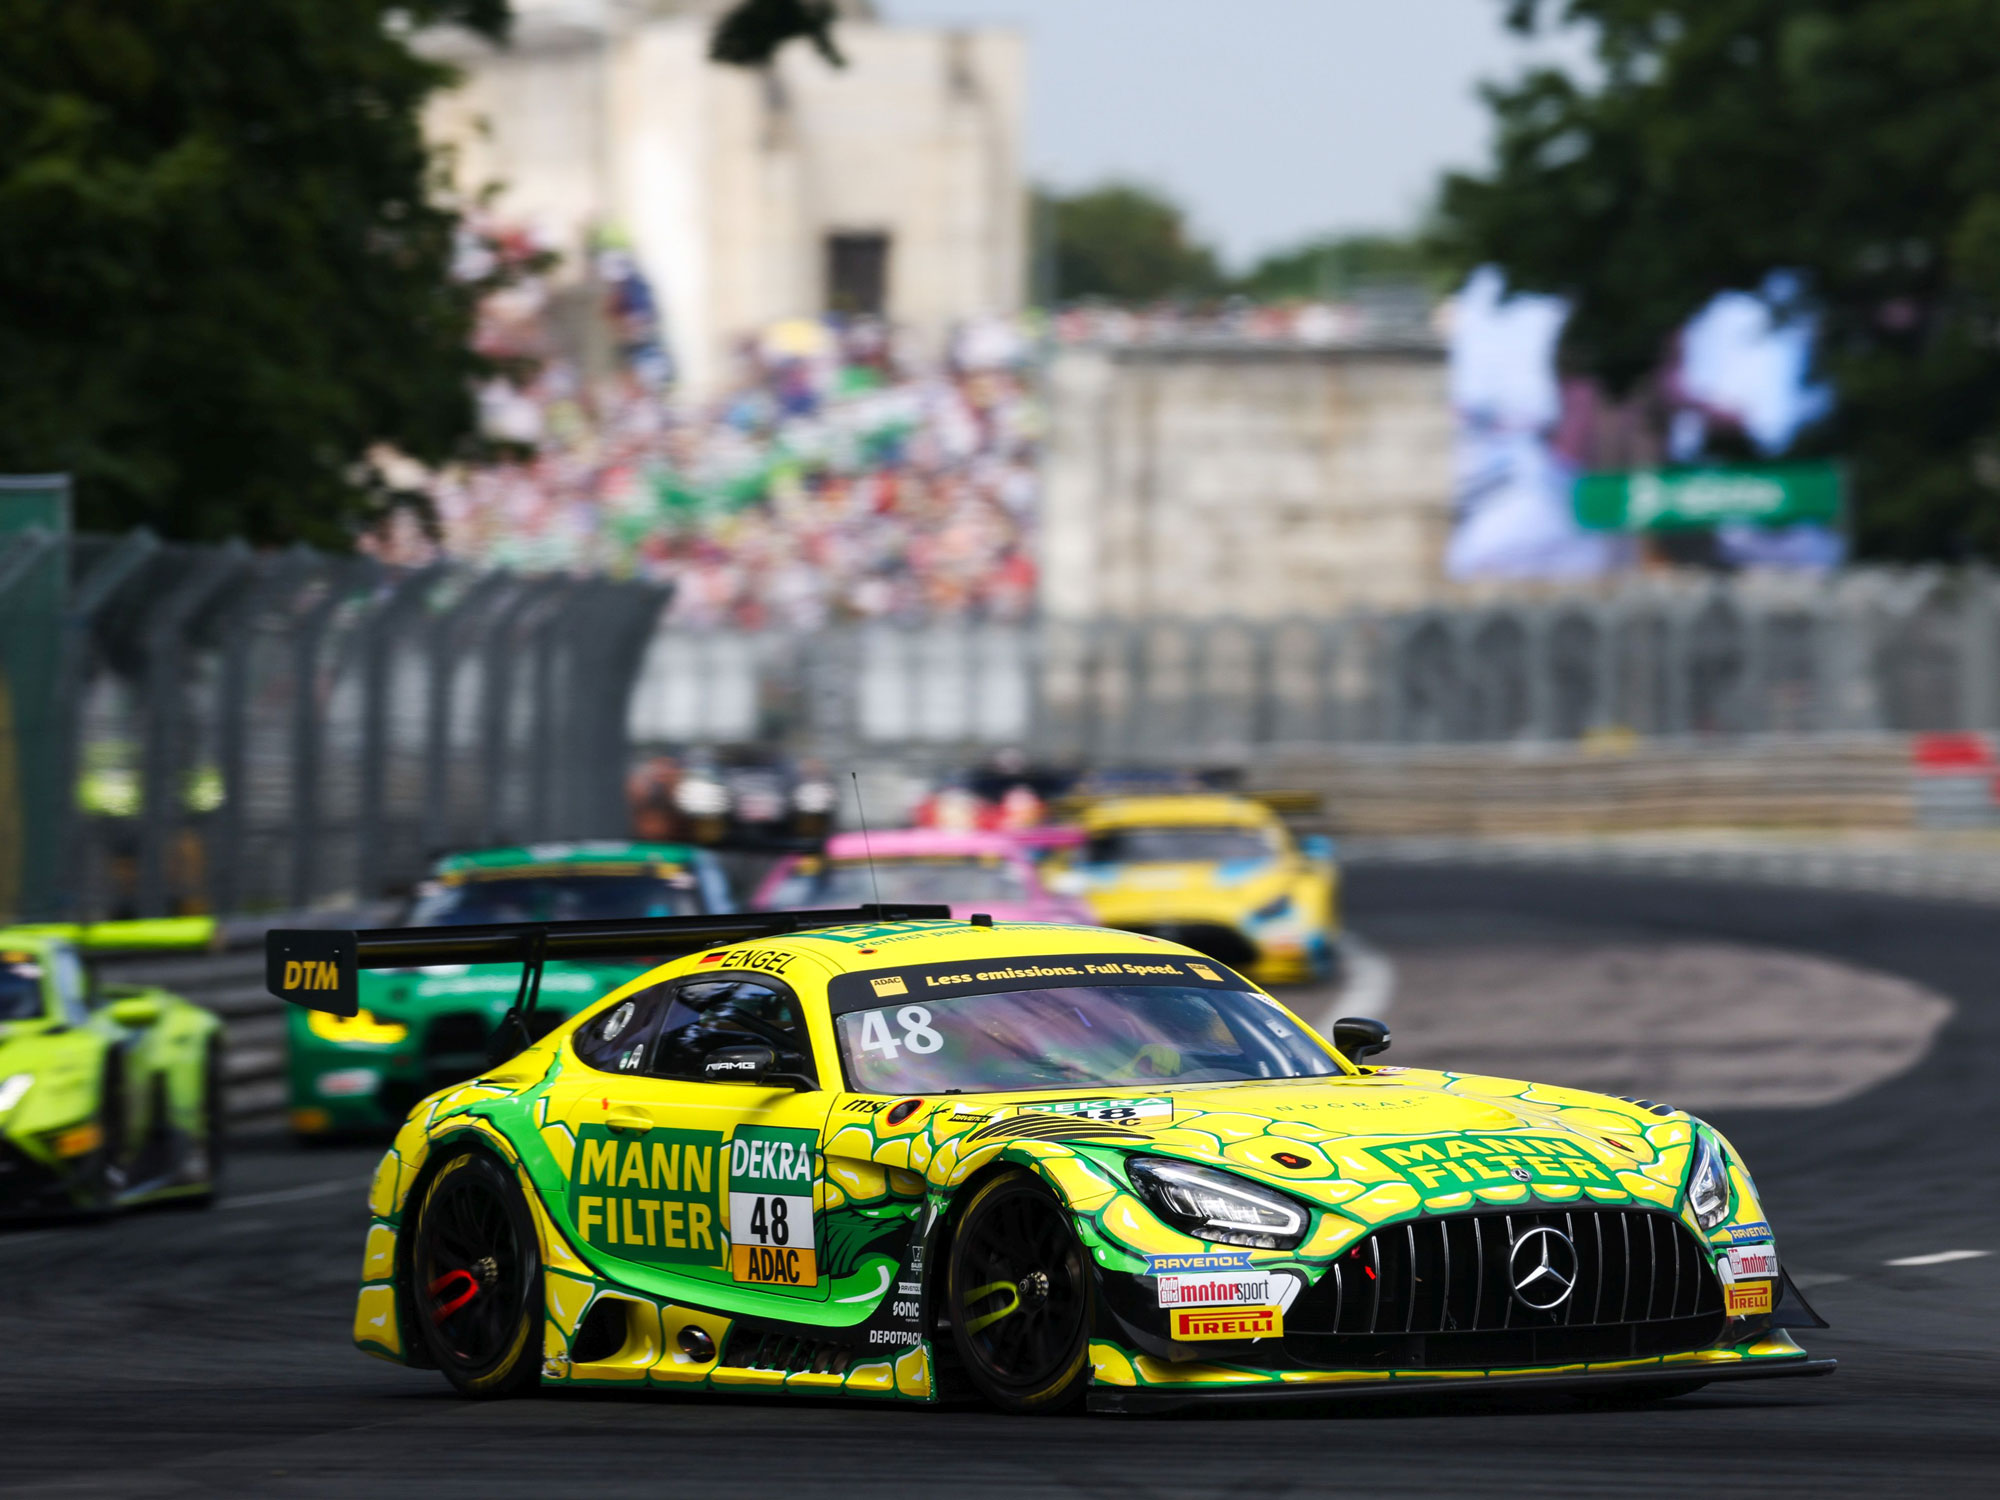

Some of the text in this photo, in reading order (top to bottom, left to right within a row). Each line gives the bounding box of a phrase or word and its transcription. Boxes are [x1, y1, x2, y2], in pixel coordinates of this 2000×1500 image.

[721, 951, 797, 975] ENGEL
[926, 963, 1184, 987] Less emissions. Full Speed.
[283, 961, 339, 990] DTM
[874, 977, 901, 987] ADAC
[861, 1005, 944, 1060] 48
[719, 1062, 755, 1070] AMG
[842, 1099, 892, 1114] msi
[1024, 1097, 1167, 1112] DEKRA
[732, 1139, 812, 1181] DEKRA
[1380, 1139, 1583, 1165] MANN
[580, 1139, 712, 1193] MANN
[1407, 1155, 1611, 1189] FILTER
[577, 1196, 715, 1250] FILTER
[751, 1197, 789, 1246] 48
[1731, 1226, 1771, 1239] RAVENOL
[748, 1248, 800, 1284] ADAC
[1154, 1257, 1244, 1270] RAVENOL
[1180, 1279, 1269, 1303] motorsport
[1729, 1287, 1768, 1310] PIRELLI
[893, 1301, 919, 1318] SONIC
[1179, 1310, 1273, 1335] PIRELLI
[869, 1330, 922, 1345] DEPOTPACK
